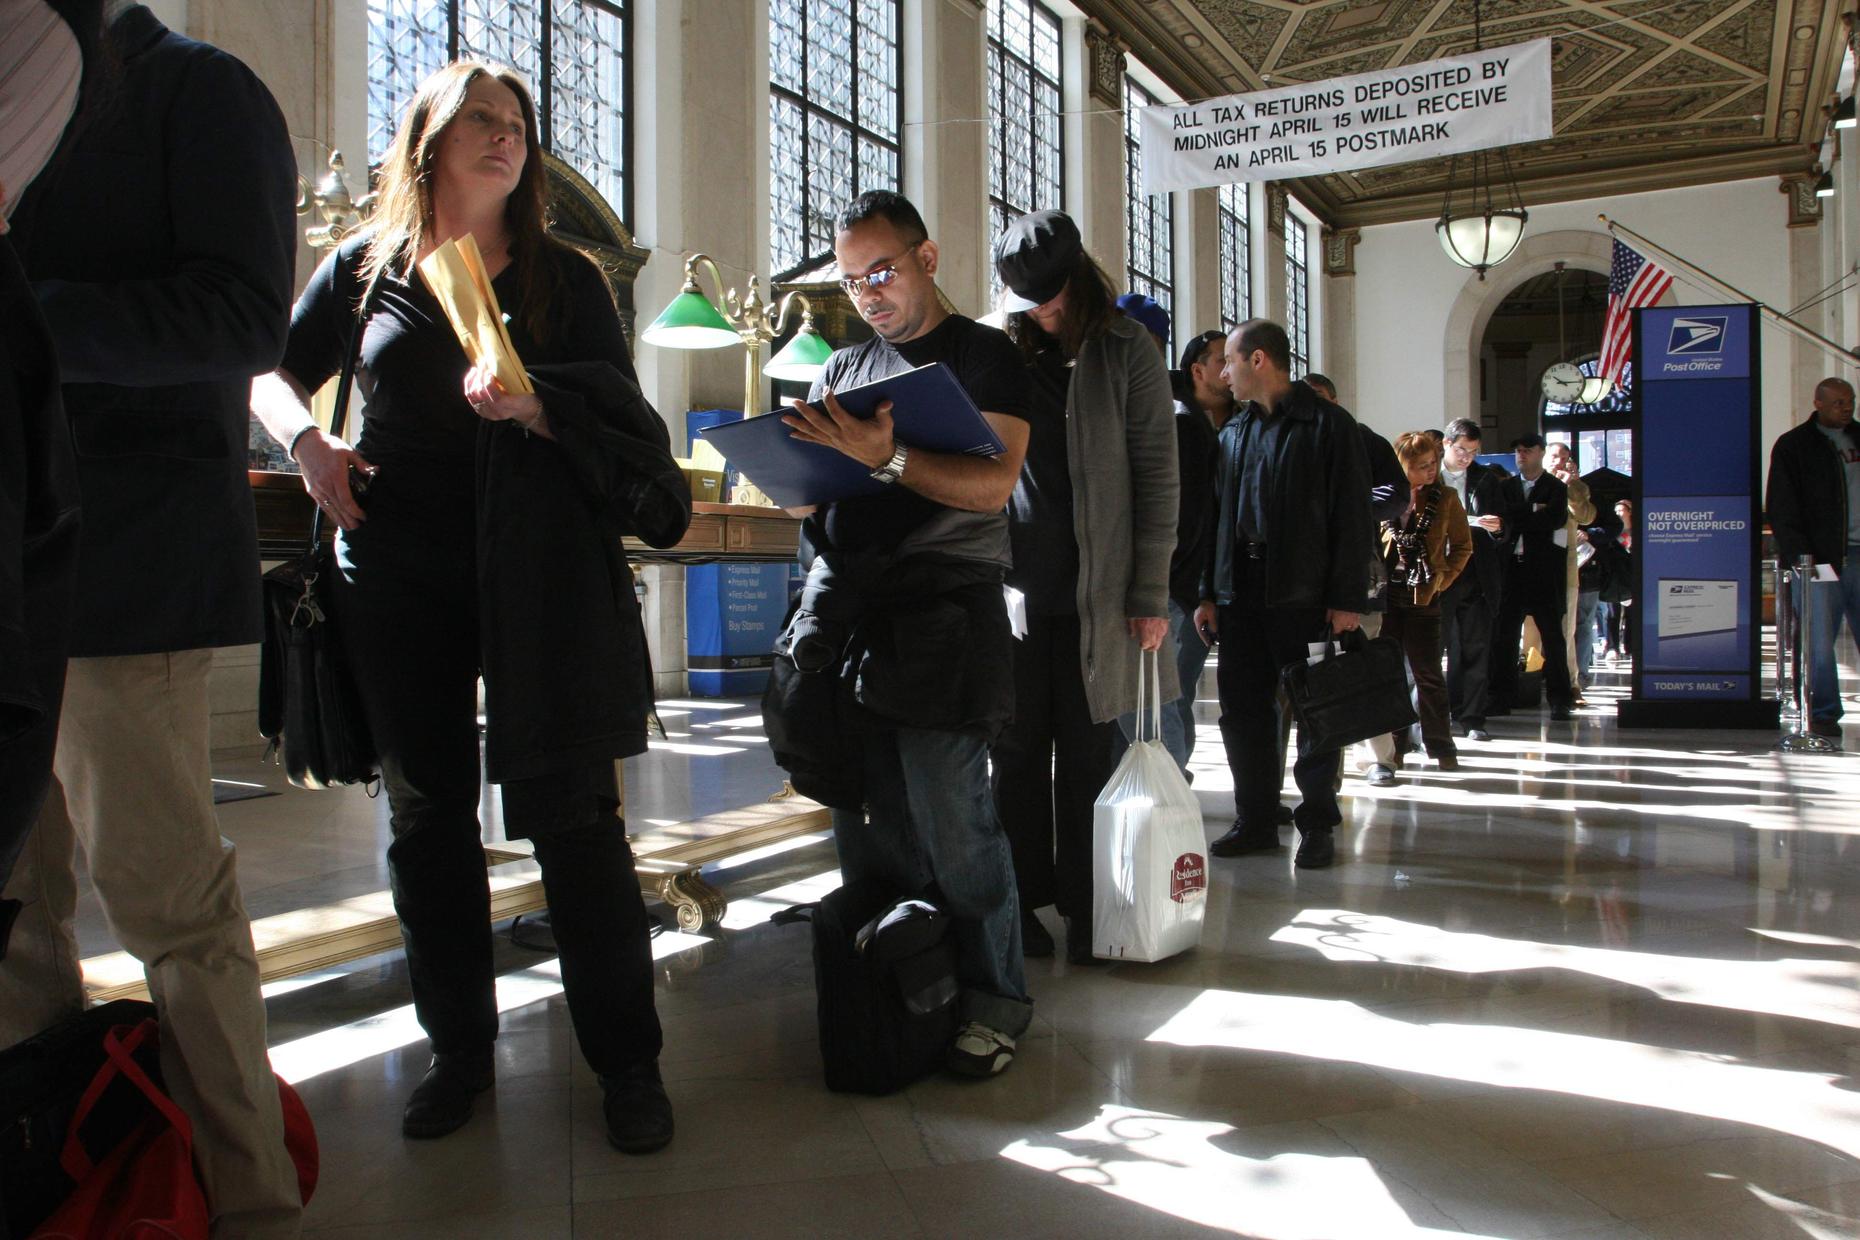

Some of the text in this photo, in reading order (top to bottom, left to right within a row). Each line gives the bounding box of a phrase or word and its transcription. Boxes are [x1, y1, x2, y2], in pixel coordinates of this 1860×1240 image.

[1173, 58, 1510, 130] ALL TAX RETURNS DEPOSITED BY
[1174, 85, 1508, 151] MIDNIGHT APRIL 15 WILL RECEIVE
[1214, 121, 1450, 170] AN APRIL 15 POSTMARK
[1663, 362, 1721, 372] Post Office
[726, 468, 740, 483] Vis
[1648, 511, 1714, 521] OVERNIGHT
[1648, 520, 1745, 531] NOT OVERPRICED
[728, 620, 765, 632] Buy Stamps
[1654, 682, 1720, 691] TODAY'S MAIL
